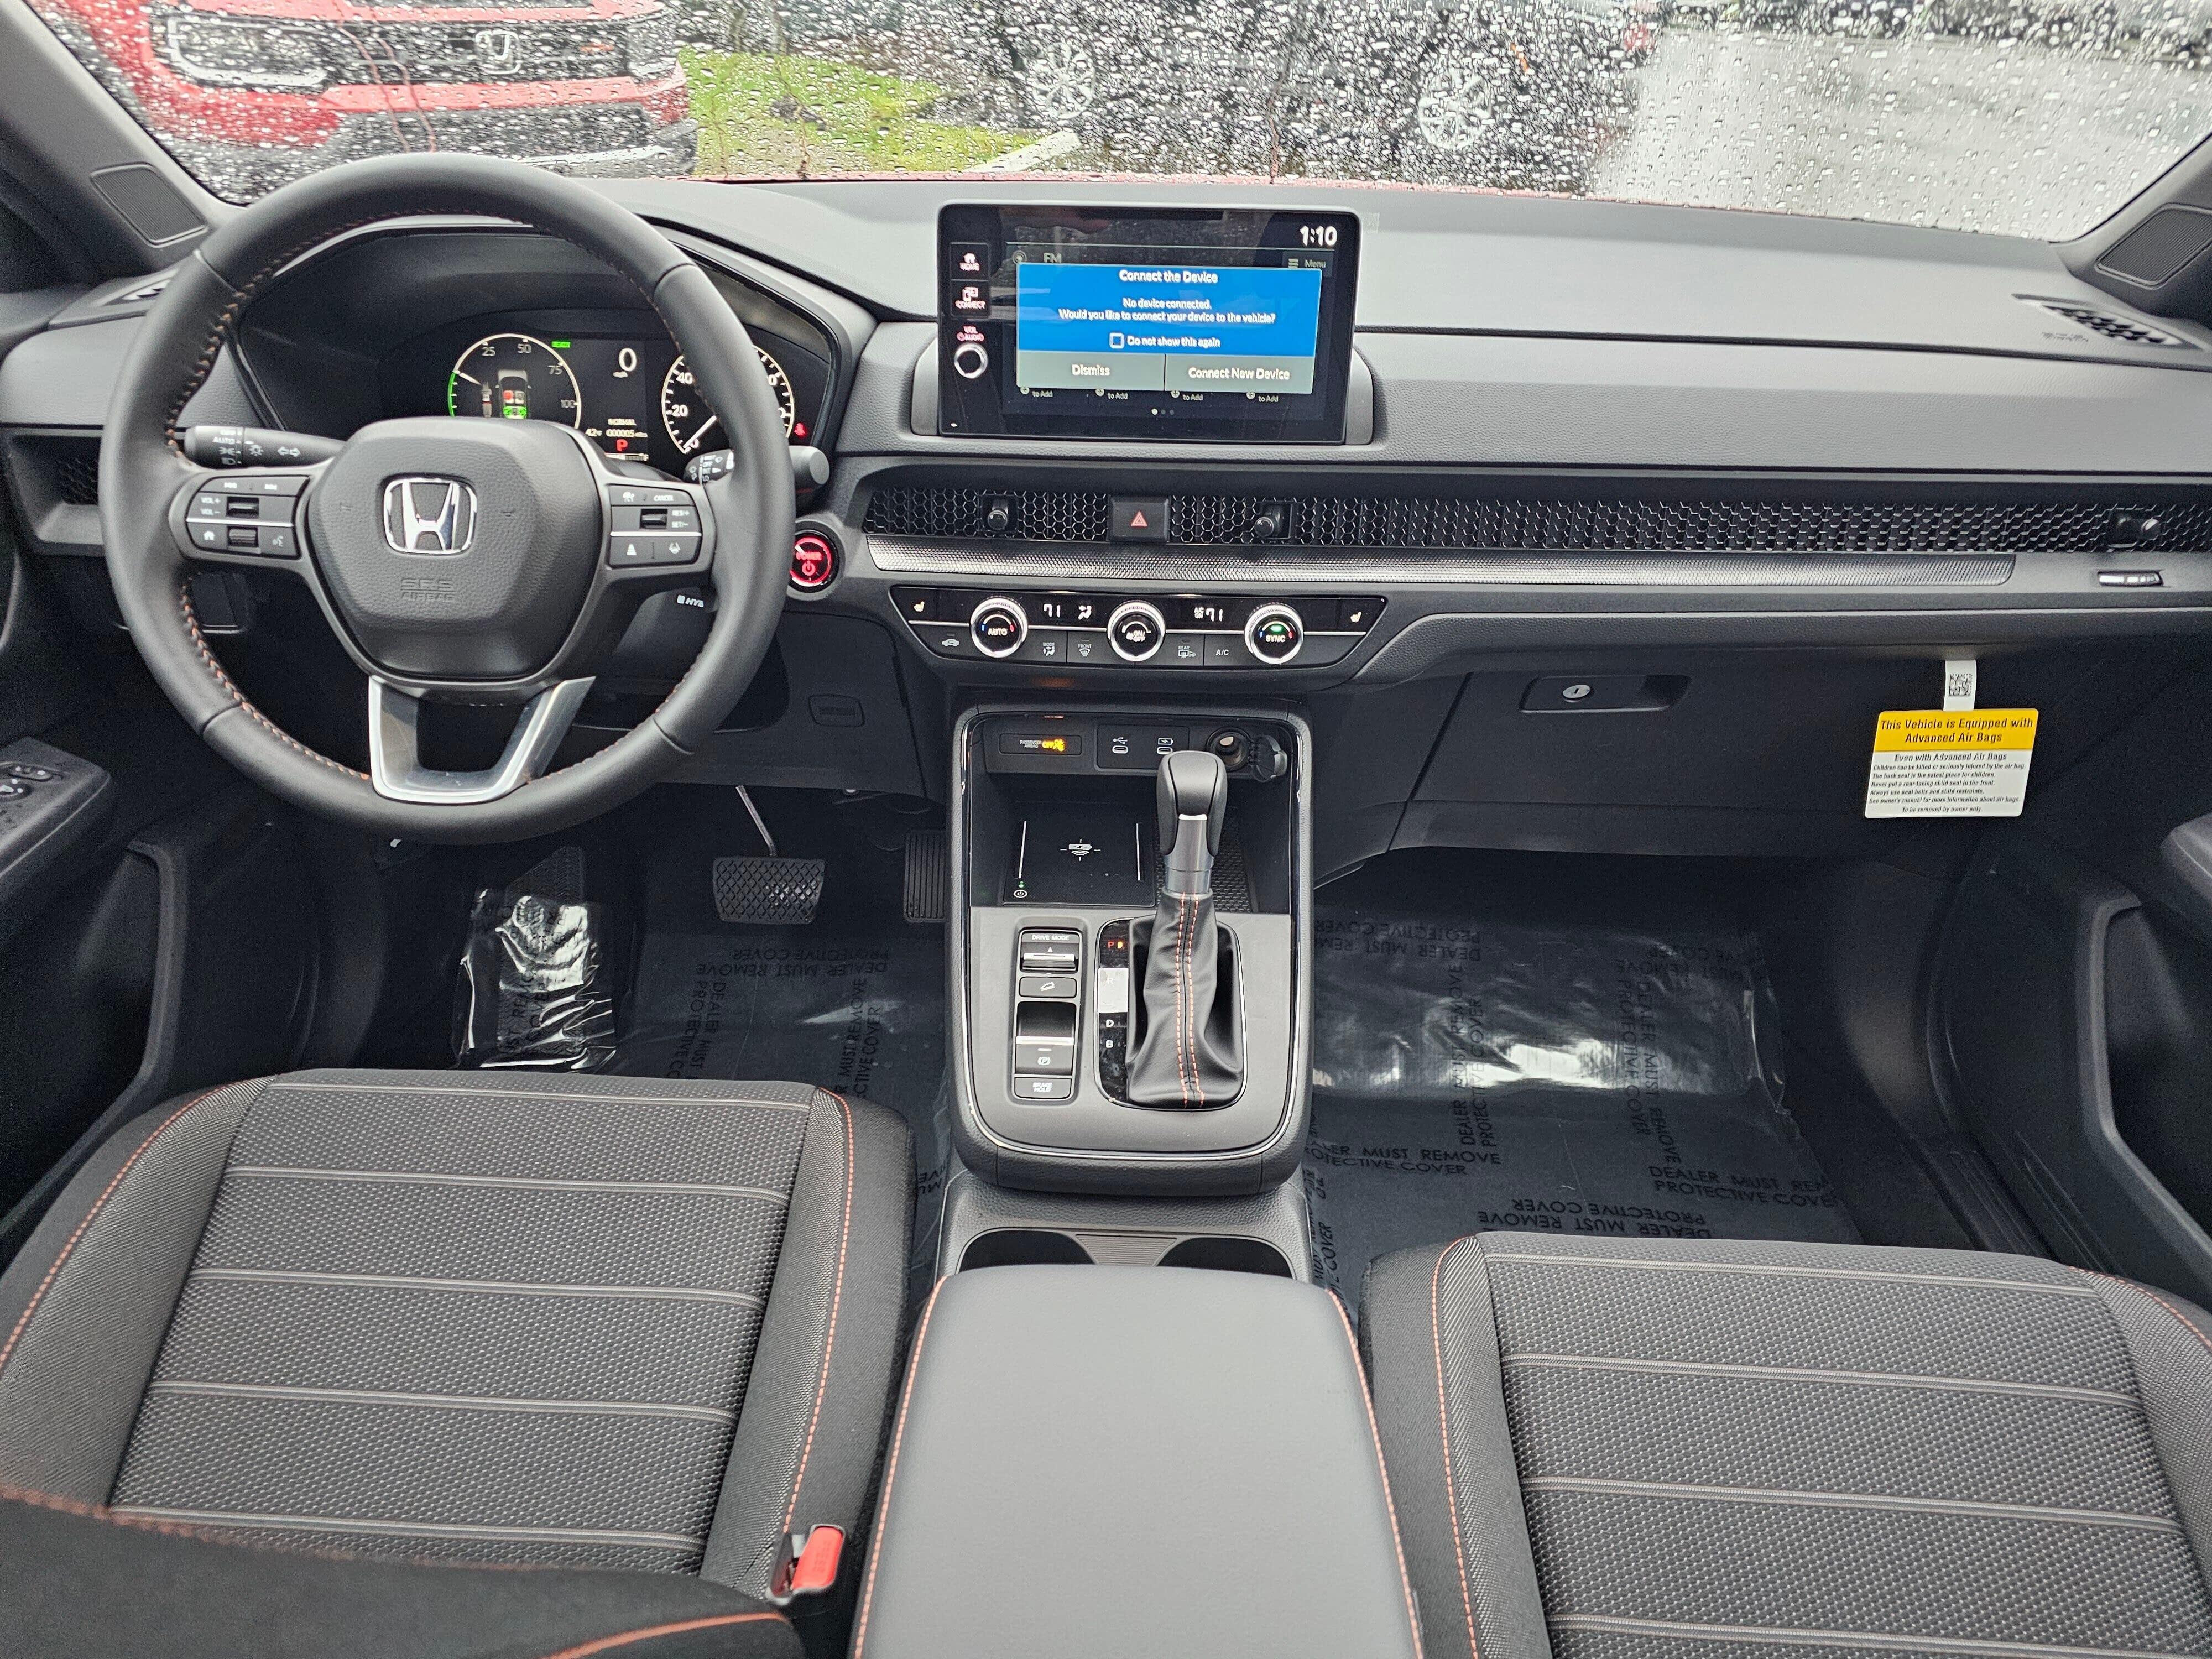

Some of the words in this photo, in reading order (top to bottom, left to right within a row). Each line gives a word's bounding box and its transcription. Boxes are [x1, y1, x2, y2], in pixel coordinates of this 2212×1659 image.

[1301, 225, 1338, 247] 1:10
[1304, 259, 1327, 268] Menu
[1119, 269, 1162, 282] Connect
[1163, 271, 1181, 283] the
[1182, 271, 1219, 283] Device
[1123, 298, 1137, 307] No
[1138, 298, 1165, 309] device
[1165, 299, 1212, 310] connected.
[1058, 309, 1088, 320] Would
[1088, 311, 1105, 321] you
[1105, 310, 1120, 320] like
[1121, 311, 1131, 320] to
[1132, 311, 1166, 321] connect
[1167, 314, 1187, 325] your
[1187, 312, 1215, 322] device
[1216, 312, 1226, 323] to
[1227, 312, 1241, 323] the
[1242, 313, 1276, 324] vehicle?
[517, 343, 532, 354] 50
[1127, 335, 1141, 346] Do
[1141, 336, 1156, 346] not
[1157, 336, 1180, 347] show
[1181, 337, 1197, 347] this
[1198, 337, 1220, 349] again
[482, 346, 495, 356] 25
[619, 347, 637, 372] 0
[547, 365, 562, 375] 75
[1072, 364, 1110, 376] Dismiss
[1188, 367, 1230, 379] Connect
[1231, 368, 1254, 379] New
[1256, 368, 1290, 380] Device
[676, 372, 693, 384] 40
[671, 404, 688, 417] 20
[617, 439, 628, 452] P
[987, 628, 1008, 637] AUTO
[1265, 635, 1286, 643] SYNC
[1880, 719, 1901, 730] This
[1906, 719, 1943, 729] Vehicle
[1947, 718, 1955, 729] is
[1959, 718, 2007, 731] Equipped
[2011, 718, 2033, 728] with
[1905, 733, 1955, 743] Advanced
[1958, 732, 1974, 742] Air
[1977, 732, 2002, 743] Bags
[1916, 753, 1932, 761] with
[1933, 753, 1971, 761] Advanced
[1987, 752, 2007, 761] Bags
[696, 963, 765, 978] REMOVE
[774, 964, 818, 978] MUST
[828, 962, 887, 977] DEALER
[837, 1044, 855, 1077] MUST
[846, 978, 868, 1041] REMOVE
[1105, 1019, 1114, 1027] D
[862, 1006, 882, 1055] COVER
[1362, 1146, 1409, 1160] MUST
[1420, 1149, 1501, 1165] REMOVE
[1400, 1161, 1467, 1174] COVER
[1648, 1166, 1719, 1184] DEALER
[1730, 1175, 1778, 1191] MUST
[1655, 1180, 1770, 1203] PROTECTIVE
[1512, 1199, 1583, 1214] COVER
[1477, 1211, 1562, 1228] REMOVE
[1588, 1202, 1707, 1225] PROTECTIVE
[1575, 1217, 1625, 1233] MUST
